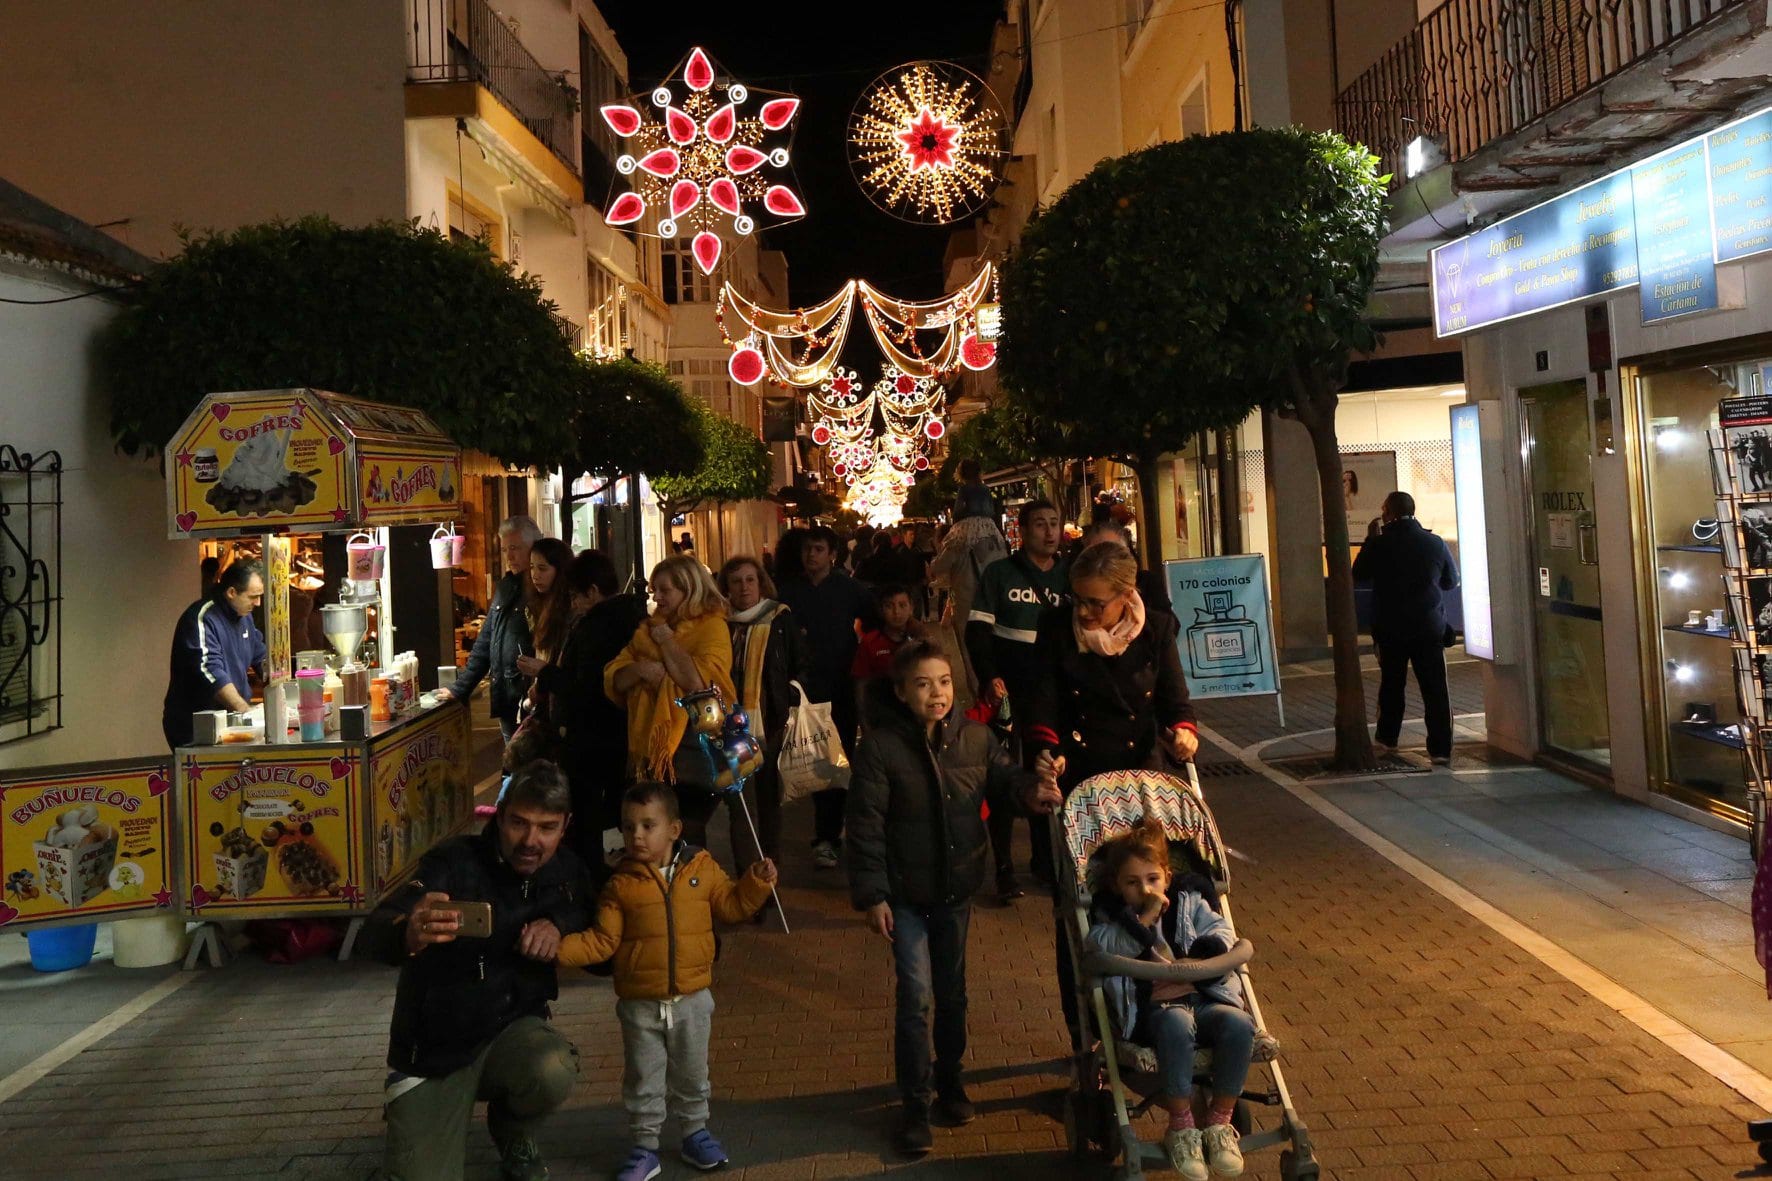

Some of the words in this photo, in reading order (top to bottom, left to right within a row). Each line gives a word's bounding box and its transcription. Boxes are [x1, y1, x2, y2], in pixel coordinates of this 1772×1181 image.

[1576, 193, 1616, 224] Jewelry
[218, 414, 303, 442] GOFRES
[391, 464, 437, 503] GOFRES
[1542, 491, 1586, 511] ROLEX
[1179, 579, 1199, 590] 170
[1201, 575, 1251, 589] colonias
[1201, 684, 1207, 692] 5
[1209, 683, 1241, 692] metros
[209, 766, 331, 802] BUÑUELOS
[10, 785, 142, 826] BUÑUELOS
[287, 808, 340, 823] GOFRES
